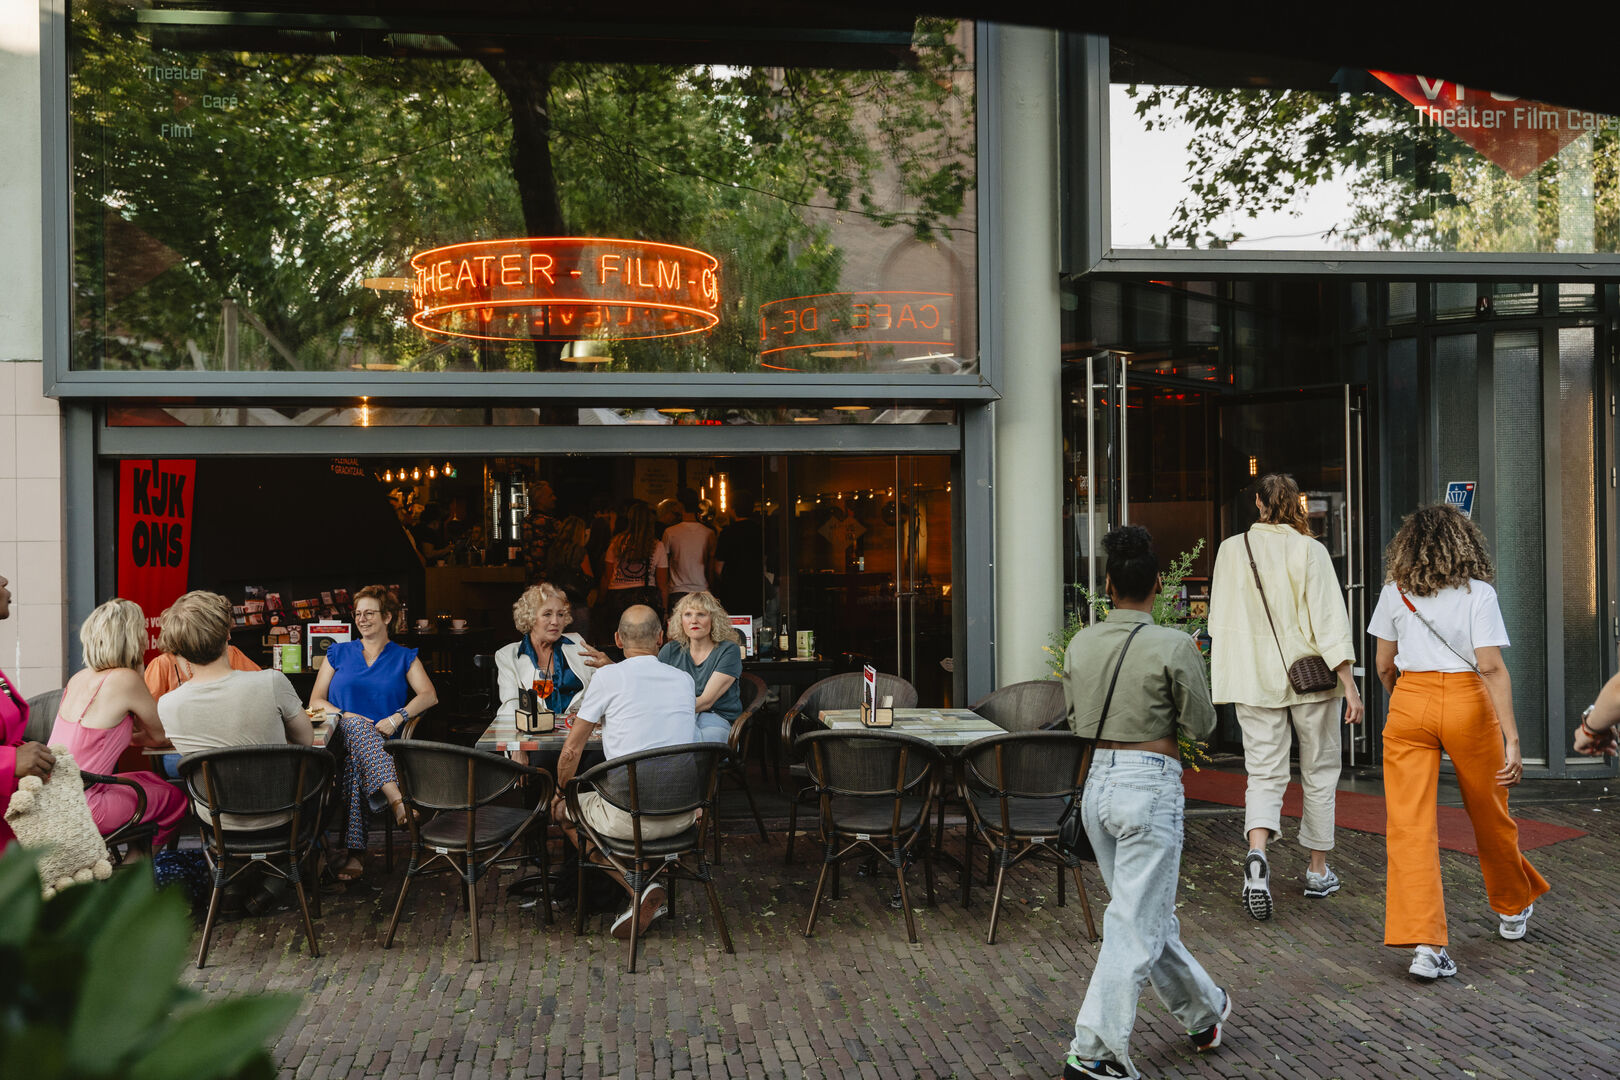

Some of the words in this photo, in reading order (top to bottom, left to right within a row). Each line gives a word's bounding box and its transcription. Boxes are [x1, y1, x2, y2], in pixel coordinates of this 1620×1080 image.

[144, 65, 208, 80] Theater
[1414, 105, 1506, 129] Theater
[1513, 106, 1560, 130] Film
[161, 123, 193, 138] Film
[601, 253, 681, 291] FILM
[132, 520, 184, 568] ONS
